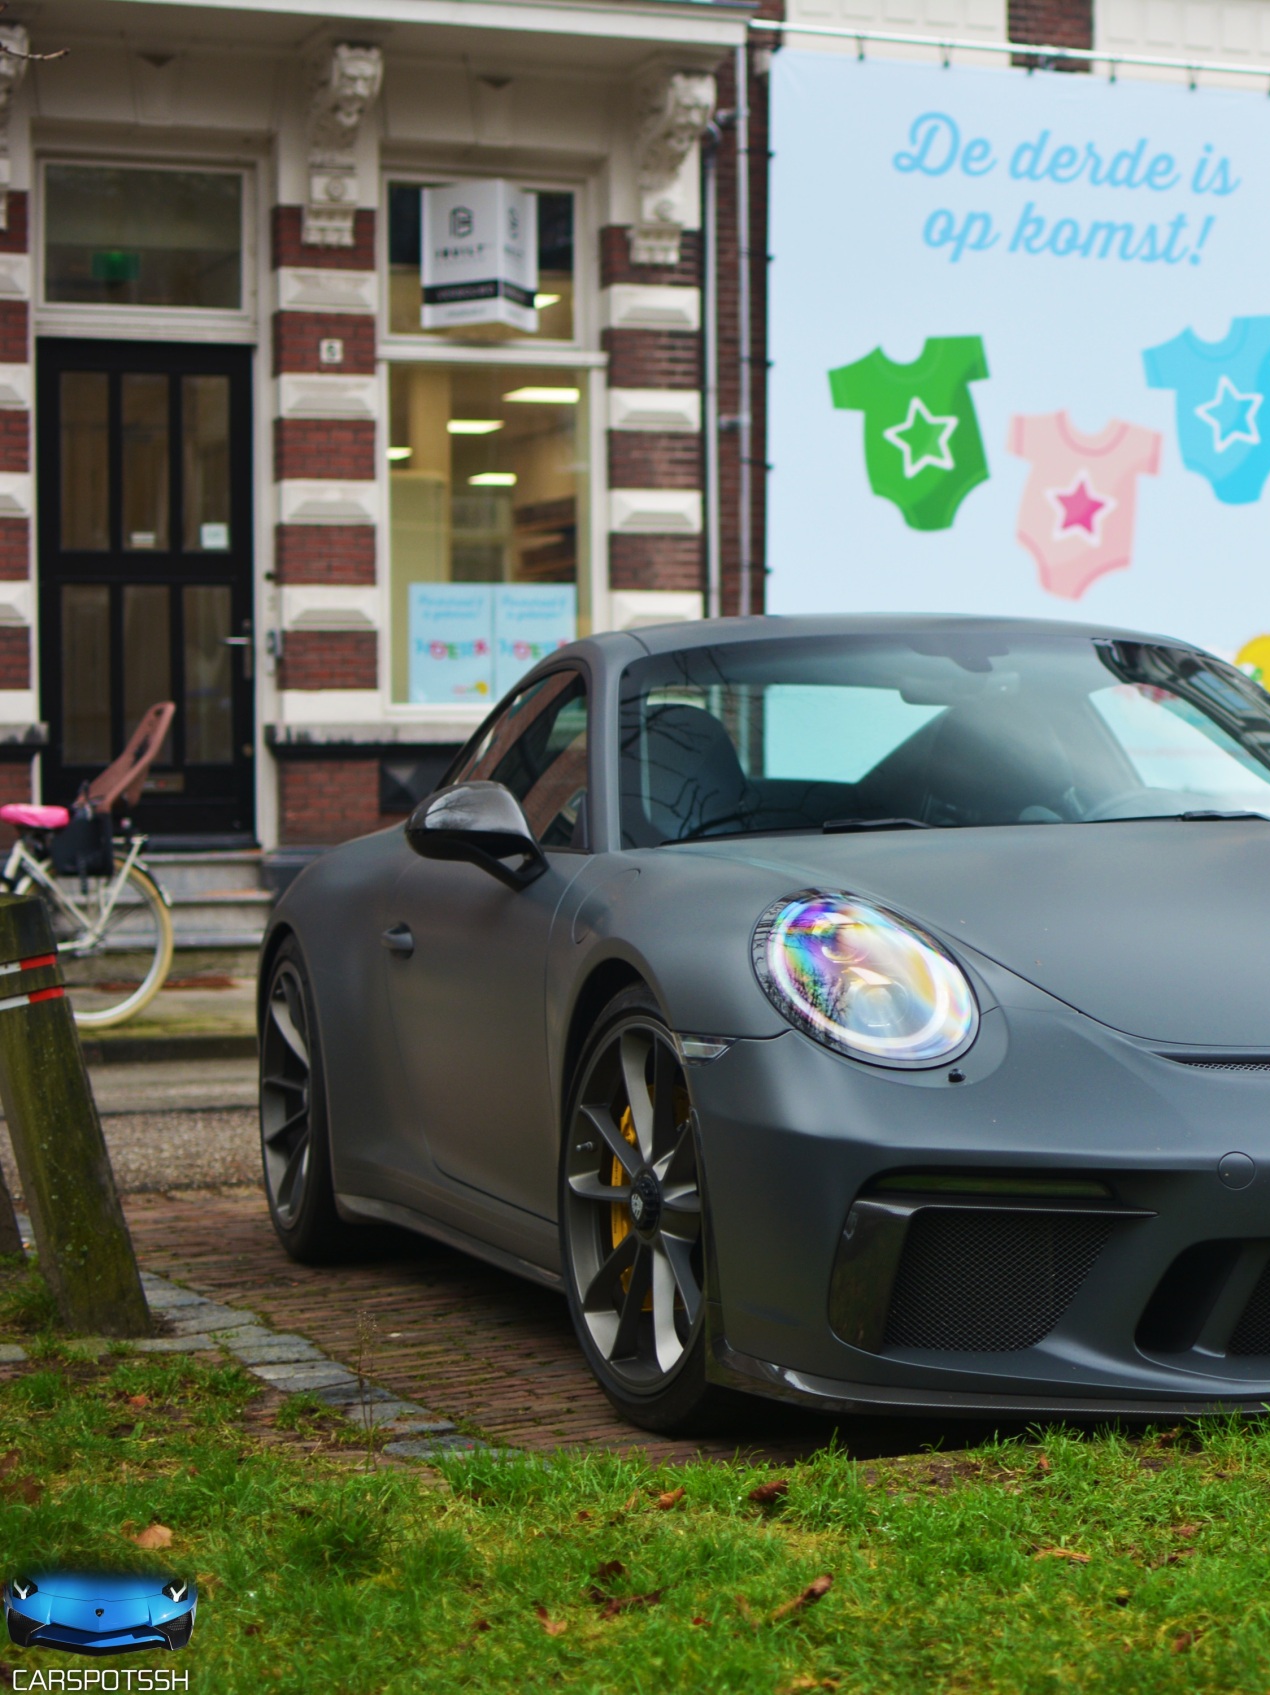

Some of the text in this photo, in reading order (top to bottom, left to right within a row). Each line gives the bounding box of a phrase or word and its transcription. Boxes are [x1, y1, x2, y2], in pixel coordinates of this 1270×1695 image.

[892, 111, 1242, 197] De derde is
[922, 201, 1217, 266] op komst!
